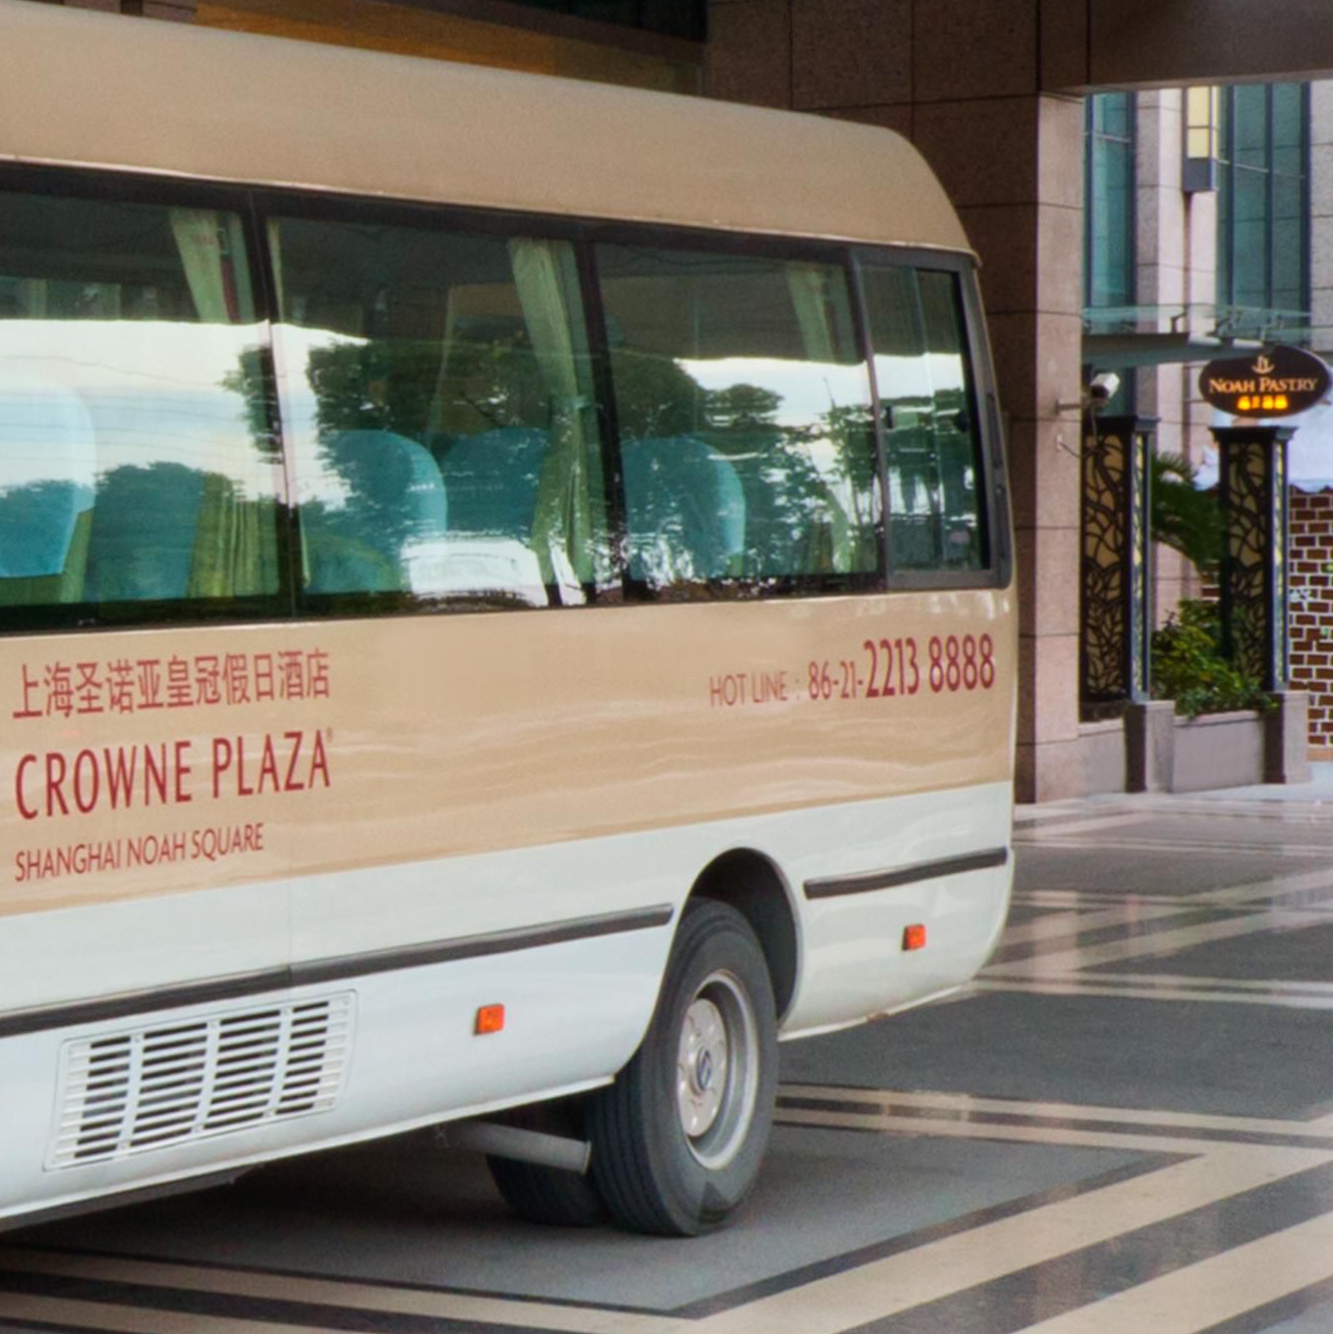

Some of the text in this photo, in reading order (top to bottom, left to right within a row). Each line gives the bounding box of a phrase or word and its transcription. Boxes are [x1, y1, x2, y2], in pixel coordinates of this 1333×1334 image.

[1208, 376, 1317, 394] NOAH PASTRY
[13, 648, 331, 719] 上海圣诺亚皇冠假日酒店
[928, 633, 996, 693] 8888
[15, 729, 331, 820] CROWNE PLAZA
[15, 822, 264, 882] SHANGHAI NOAH SQUARE
